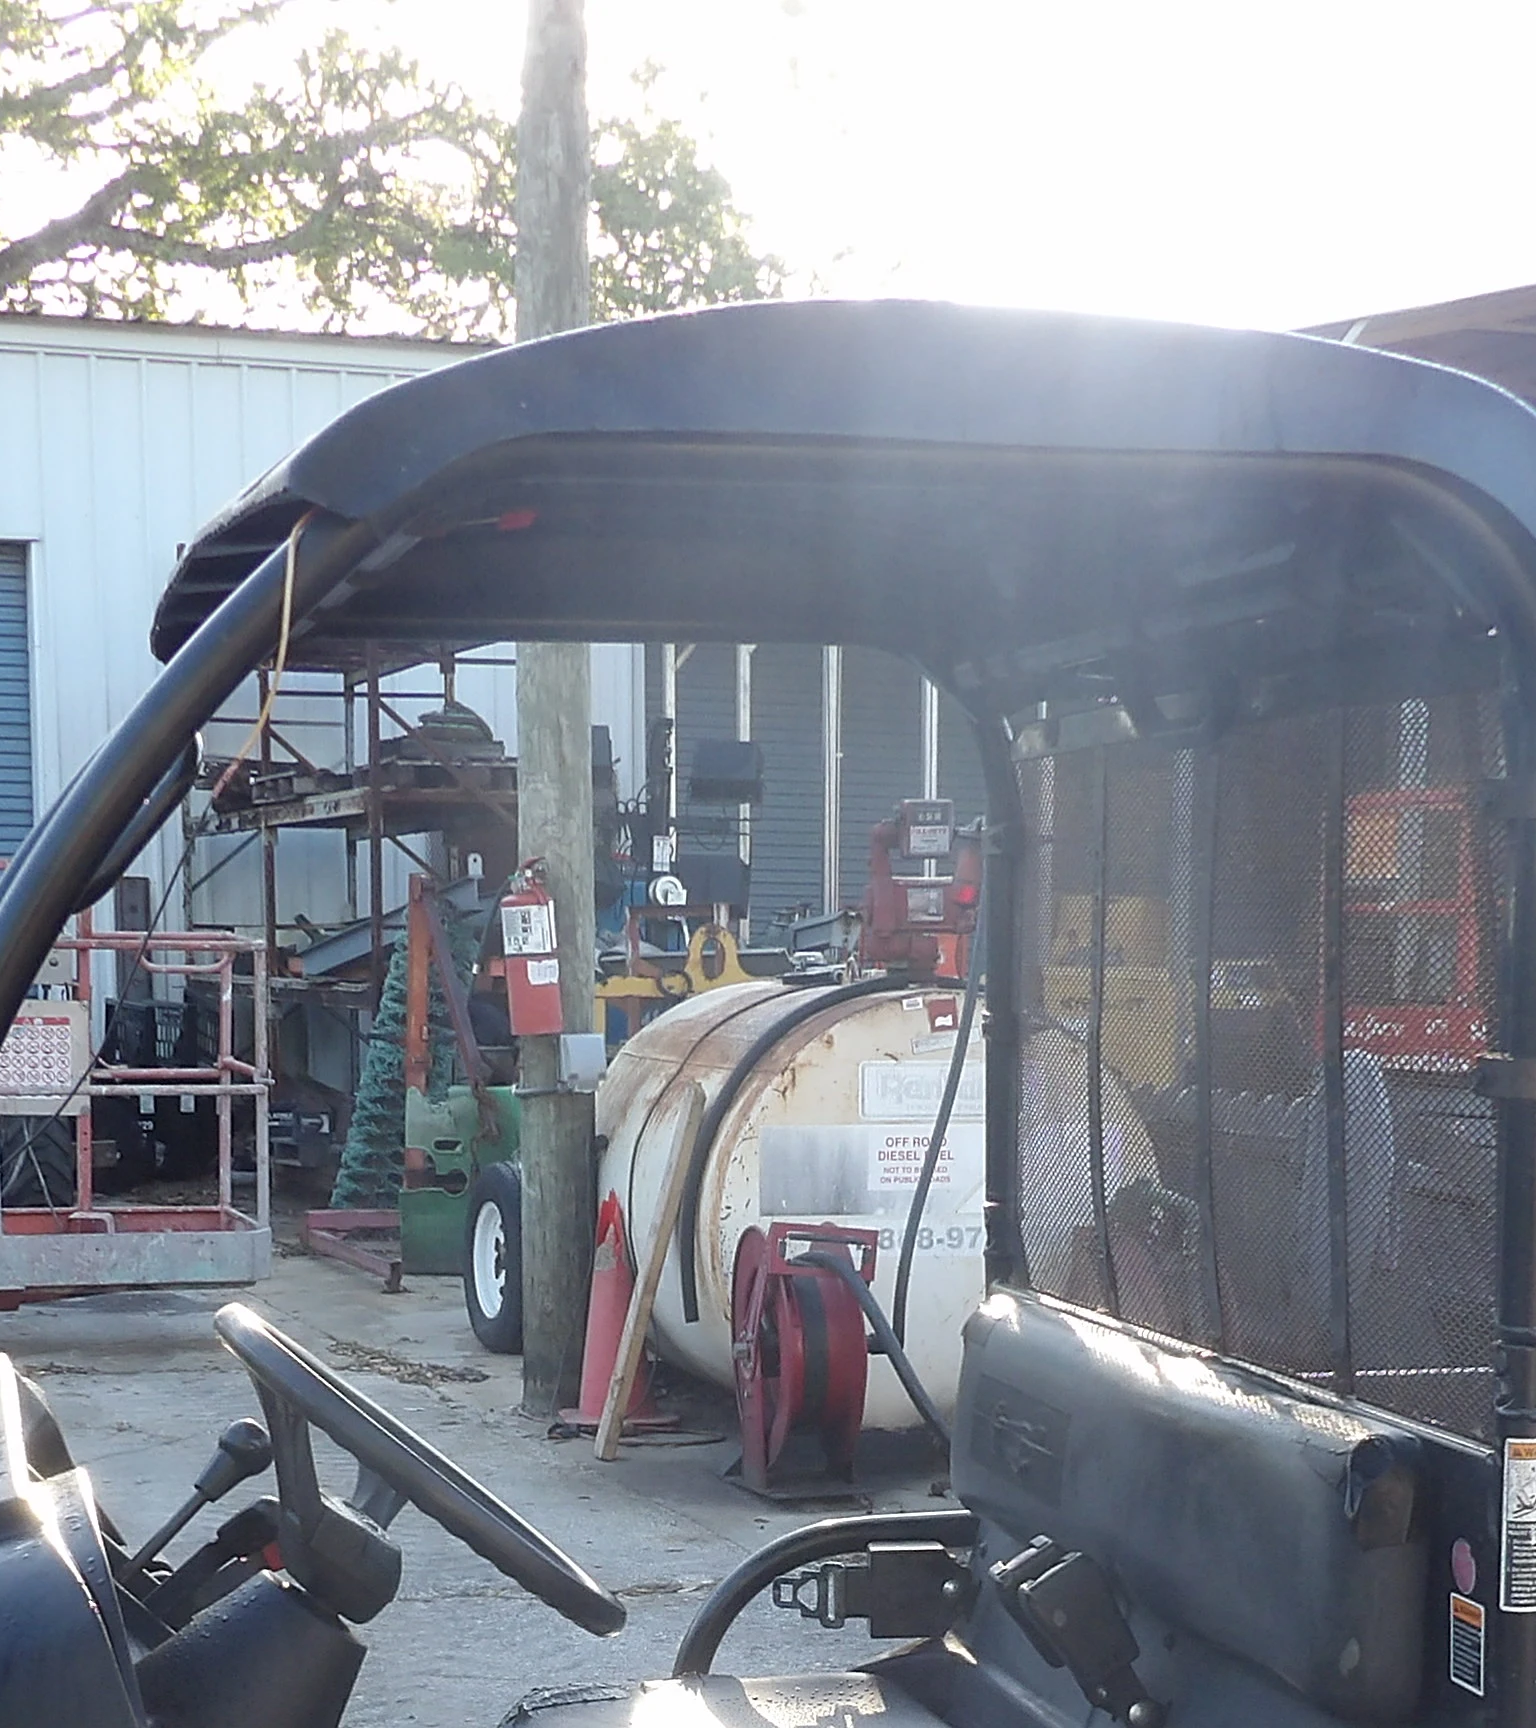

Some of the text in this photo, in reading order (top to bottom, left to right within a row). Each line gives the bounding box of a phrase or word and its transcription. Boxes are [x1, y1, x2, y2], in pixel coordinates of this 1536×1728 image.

[885, 1136, 947, 1148] OFF ROD
[878, 1150, 920, 1161] DIESEL
[879, 1226, 982, 1250] 88-97
